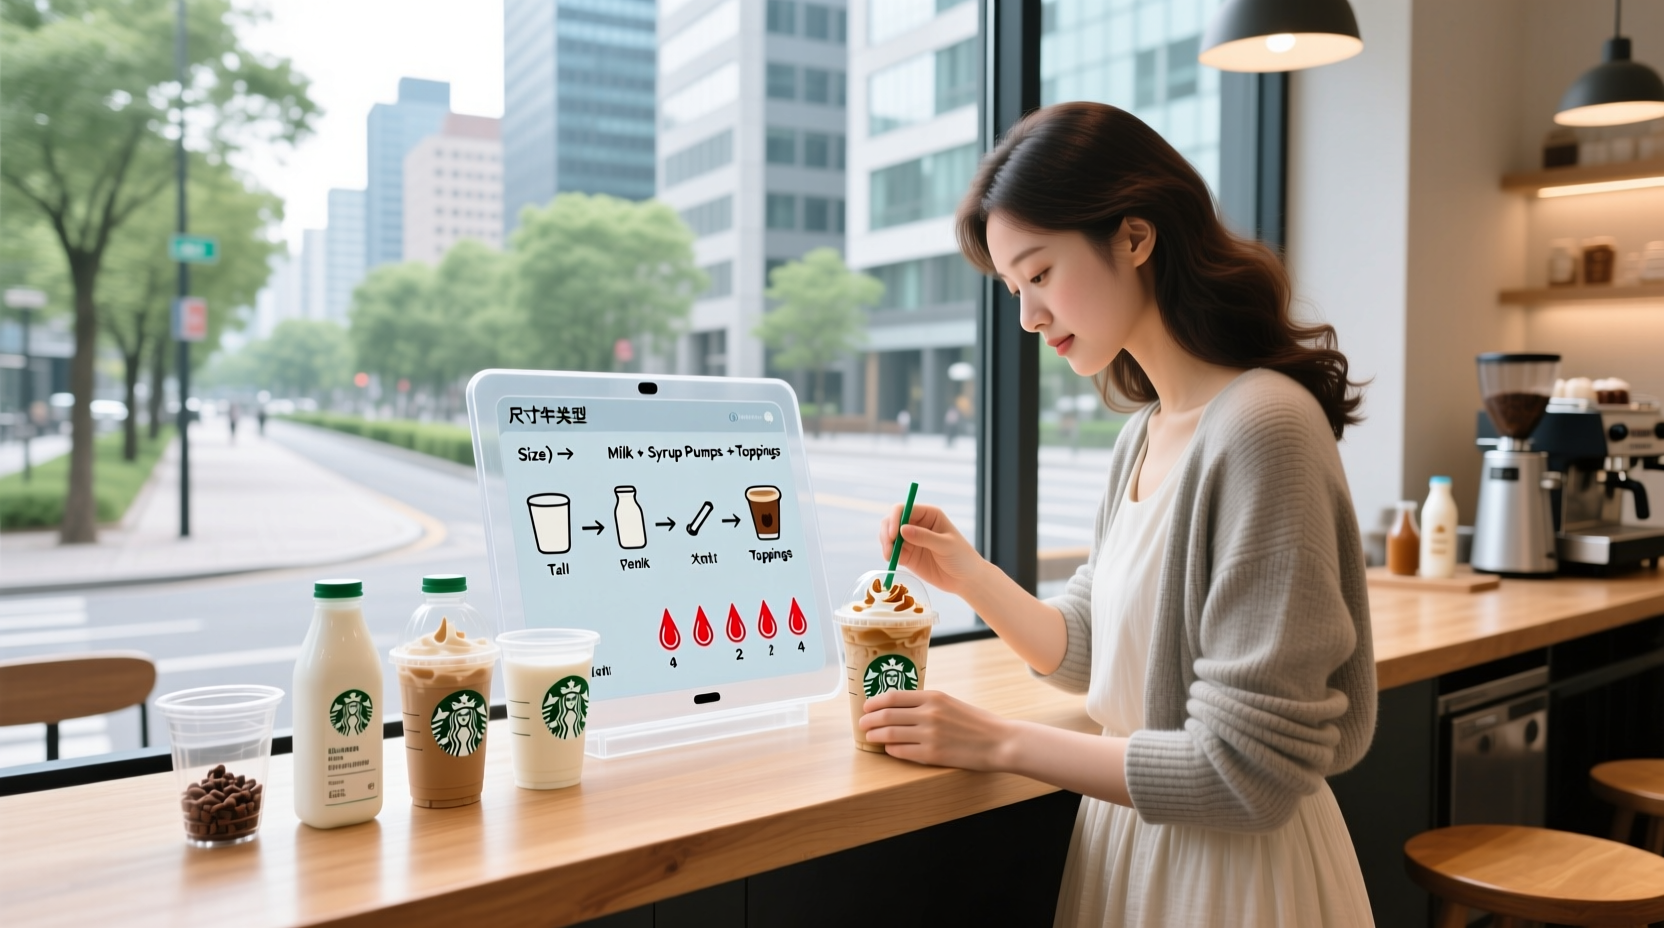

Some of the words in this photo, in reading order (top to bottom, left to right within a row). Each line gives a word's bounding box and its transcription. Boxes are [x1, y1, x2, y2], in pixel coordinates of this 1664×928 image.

[607, 445, 634, 459] Milk
[647, 446, 683, 463] Syrup
[684, 445, 724, 461] Pumps
[546, 562, 570, 576] Tall
[669, 656, 678, 668] 4
[735, 648, 744, 661] 2
[797, 640, 806, 653] 4
